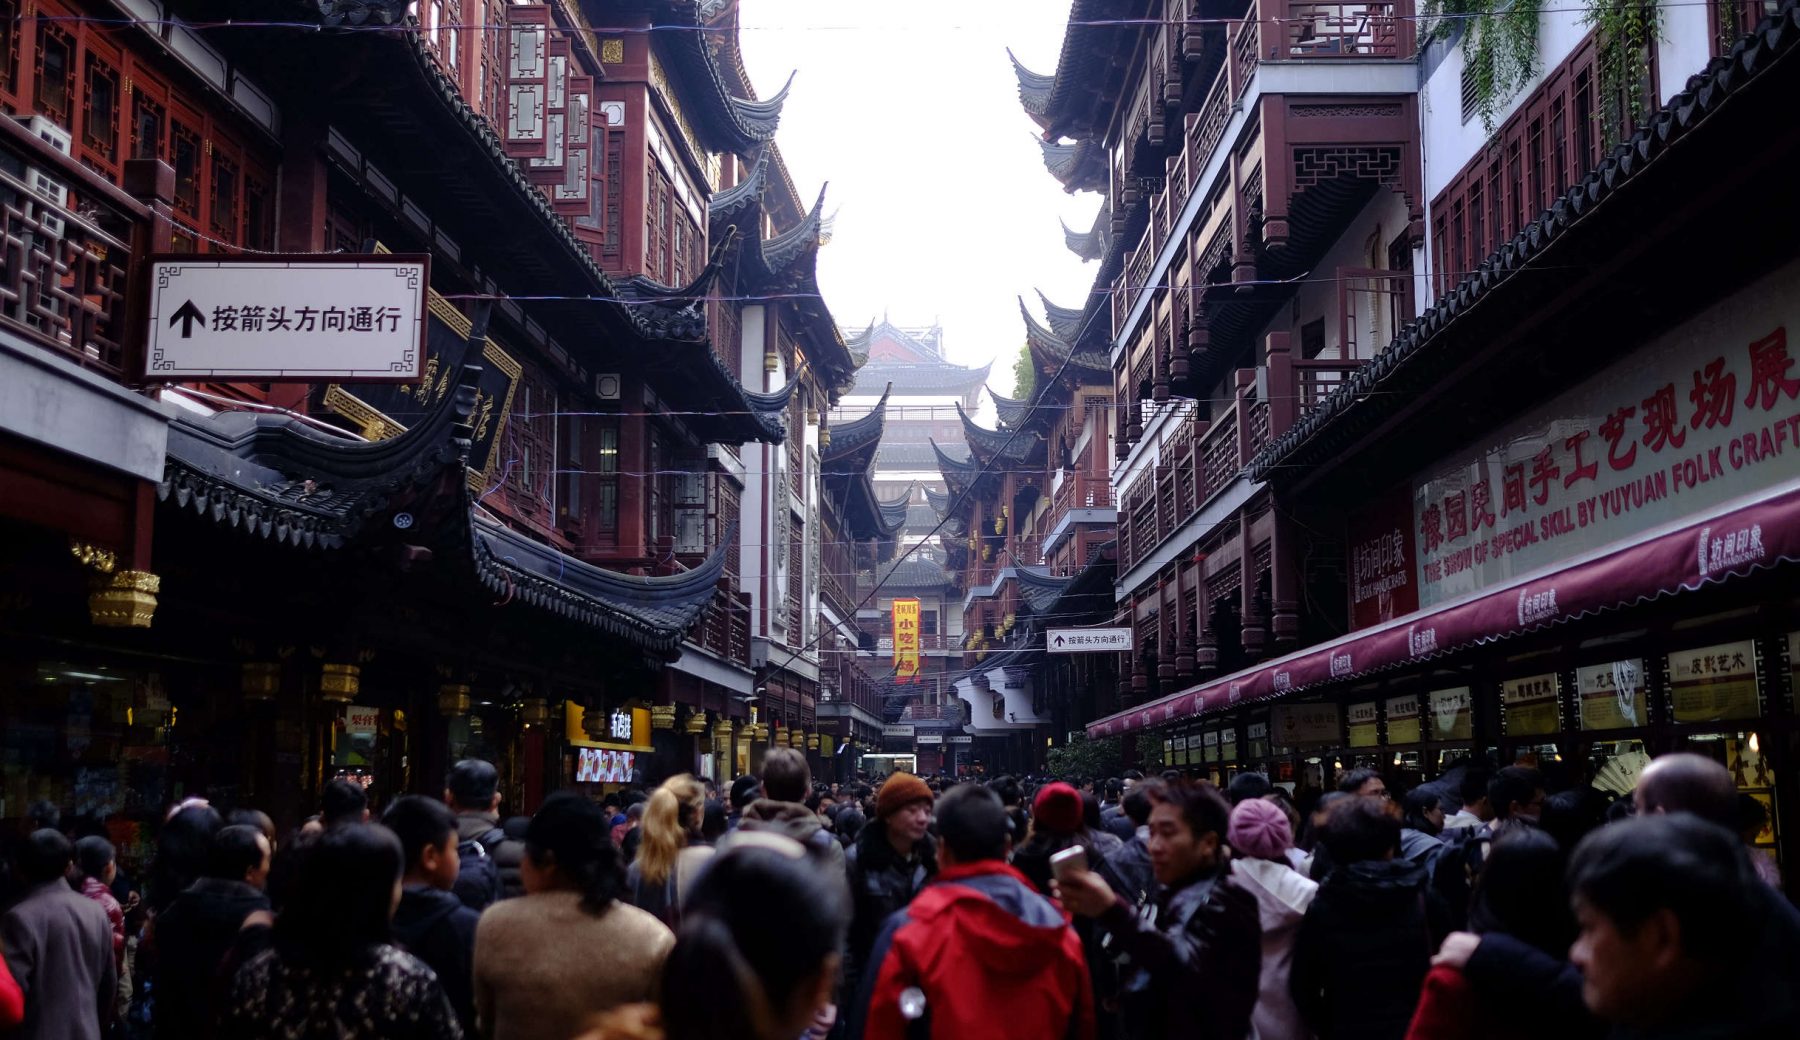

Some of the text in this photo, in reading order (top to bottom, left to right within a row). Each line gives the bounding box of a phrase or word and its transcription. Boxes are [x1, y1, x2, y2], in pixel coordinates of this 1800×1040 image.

[212, 305, 402, 333] 按箭头方向通行
[1421, 327, 1800, 555] 豫园民间手工艺现场展
[1423, 560, 1442, 584] THE
[1444, 546, 1473, 577] SHOW
[1474, 540, 1489, 565] OF
[1491, 520, 1539, 559] SPECIAL
[1540, 506, 1576, 541] SKILL
[1577, 497, 1597, 528] BY
[1600, 470, 1668, 519] YUYUAN
[1672, 446, 1724, 494] FOLK
[1360, 528, 1405, 580] 坊间印象
[1068, 634, 1125, 645] 按箭头方向通行
[1691, 652, 1745, 674] 皮影艺术
